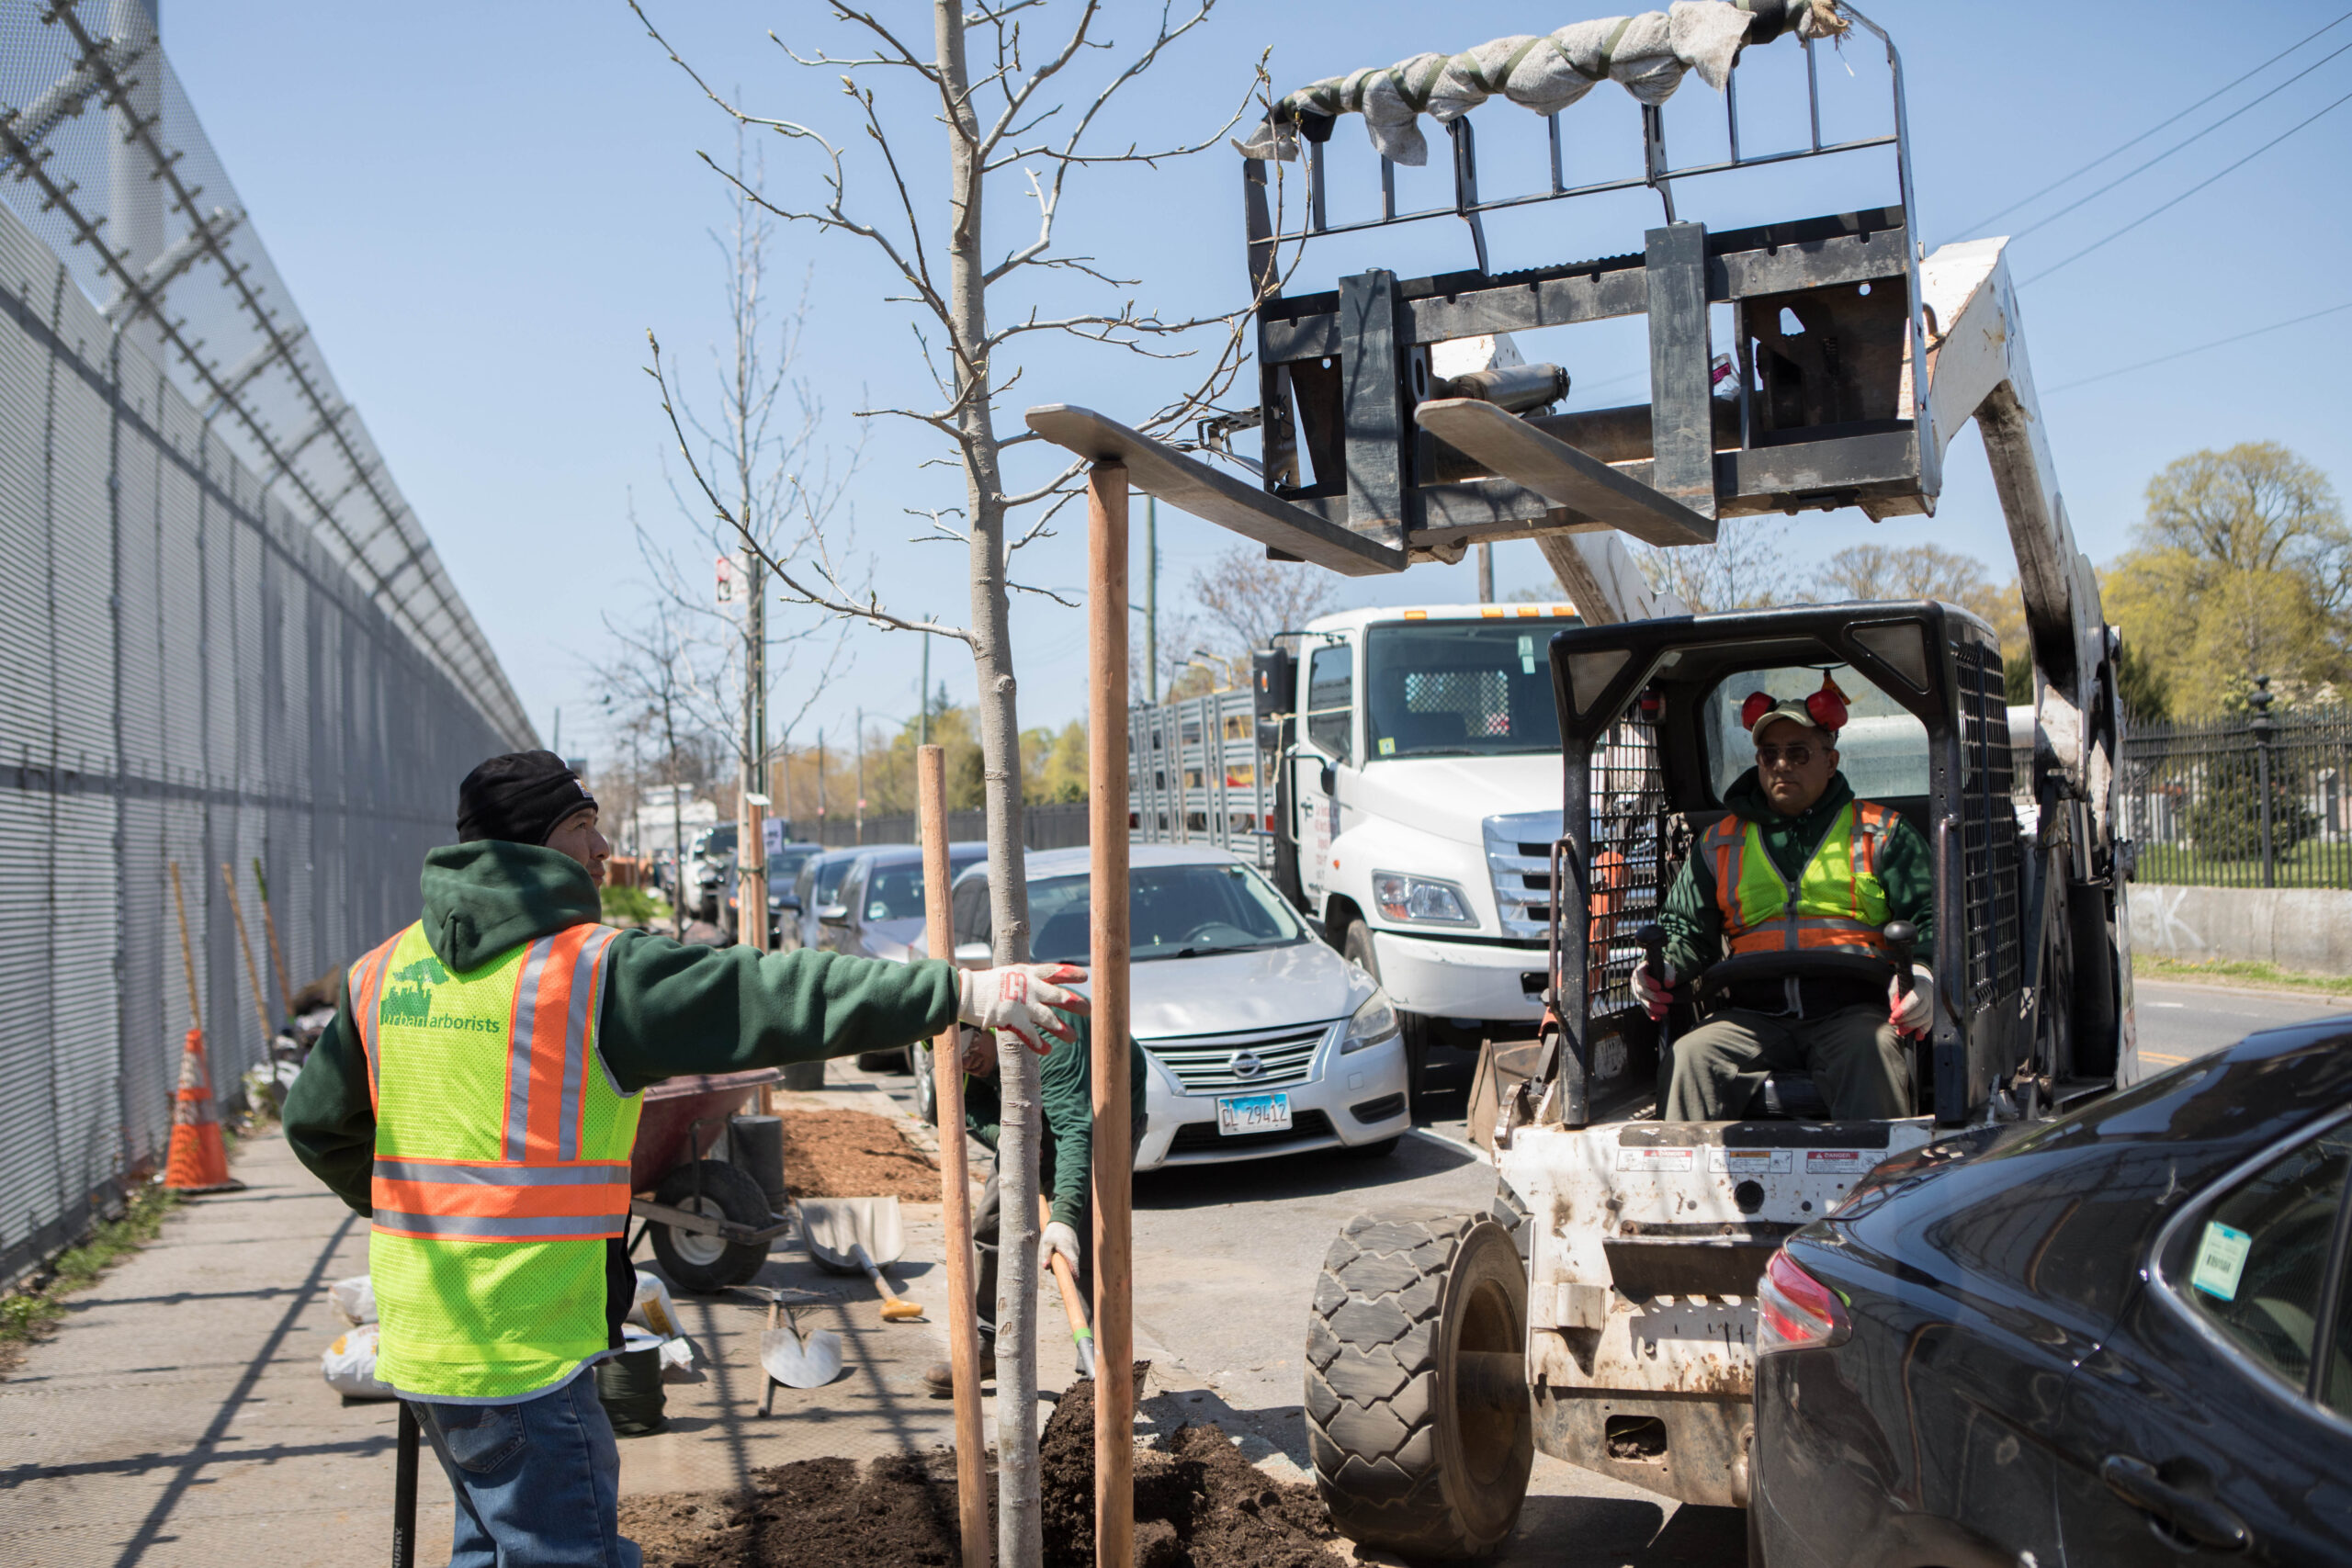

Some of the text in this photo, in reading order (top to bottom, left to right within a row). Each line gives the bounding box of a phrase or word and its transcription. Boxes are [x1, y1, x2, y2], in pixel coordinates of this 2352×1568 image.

[382, 1011, 501, 1032] urban arborists
[1246, 1102, 1287, 1124] 29412
